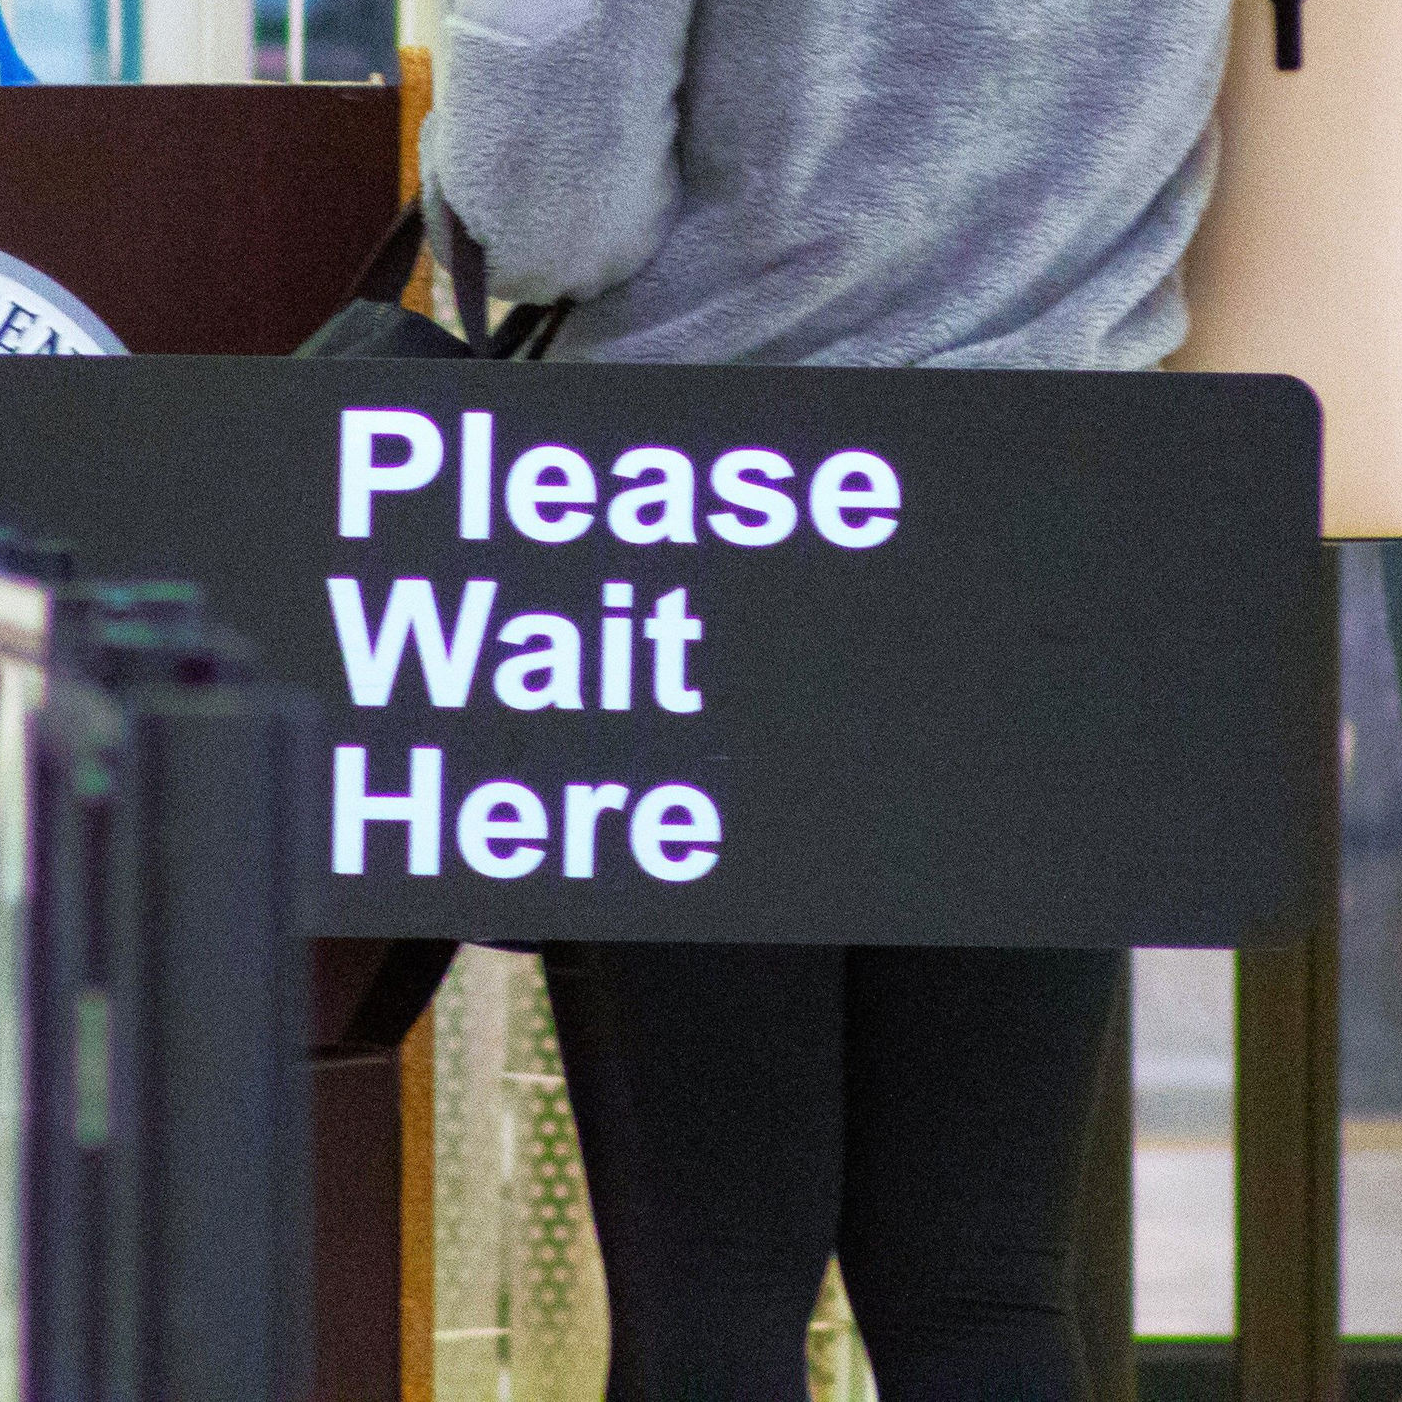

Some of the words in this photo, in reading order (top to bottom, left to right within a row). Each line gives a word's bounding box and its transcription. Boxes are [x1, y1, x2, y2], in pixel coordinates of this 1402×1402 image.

[337, 407, 901, 549] Please
[326, 575, 703, 713] Wait
[331, 745, 722, 882] Here
